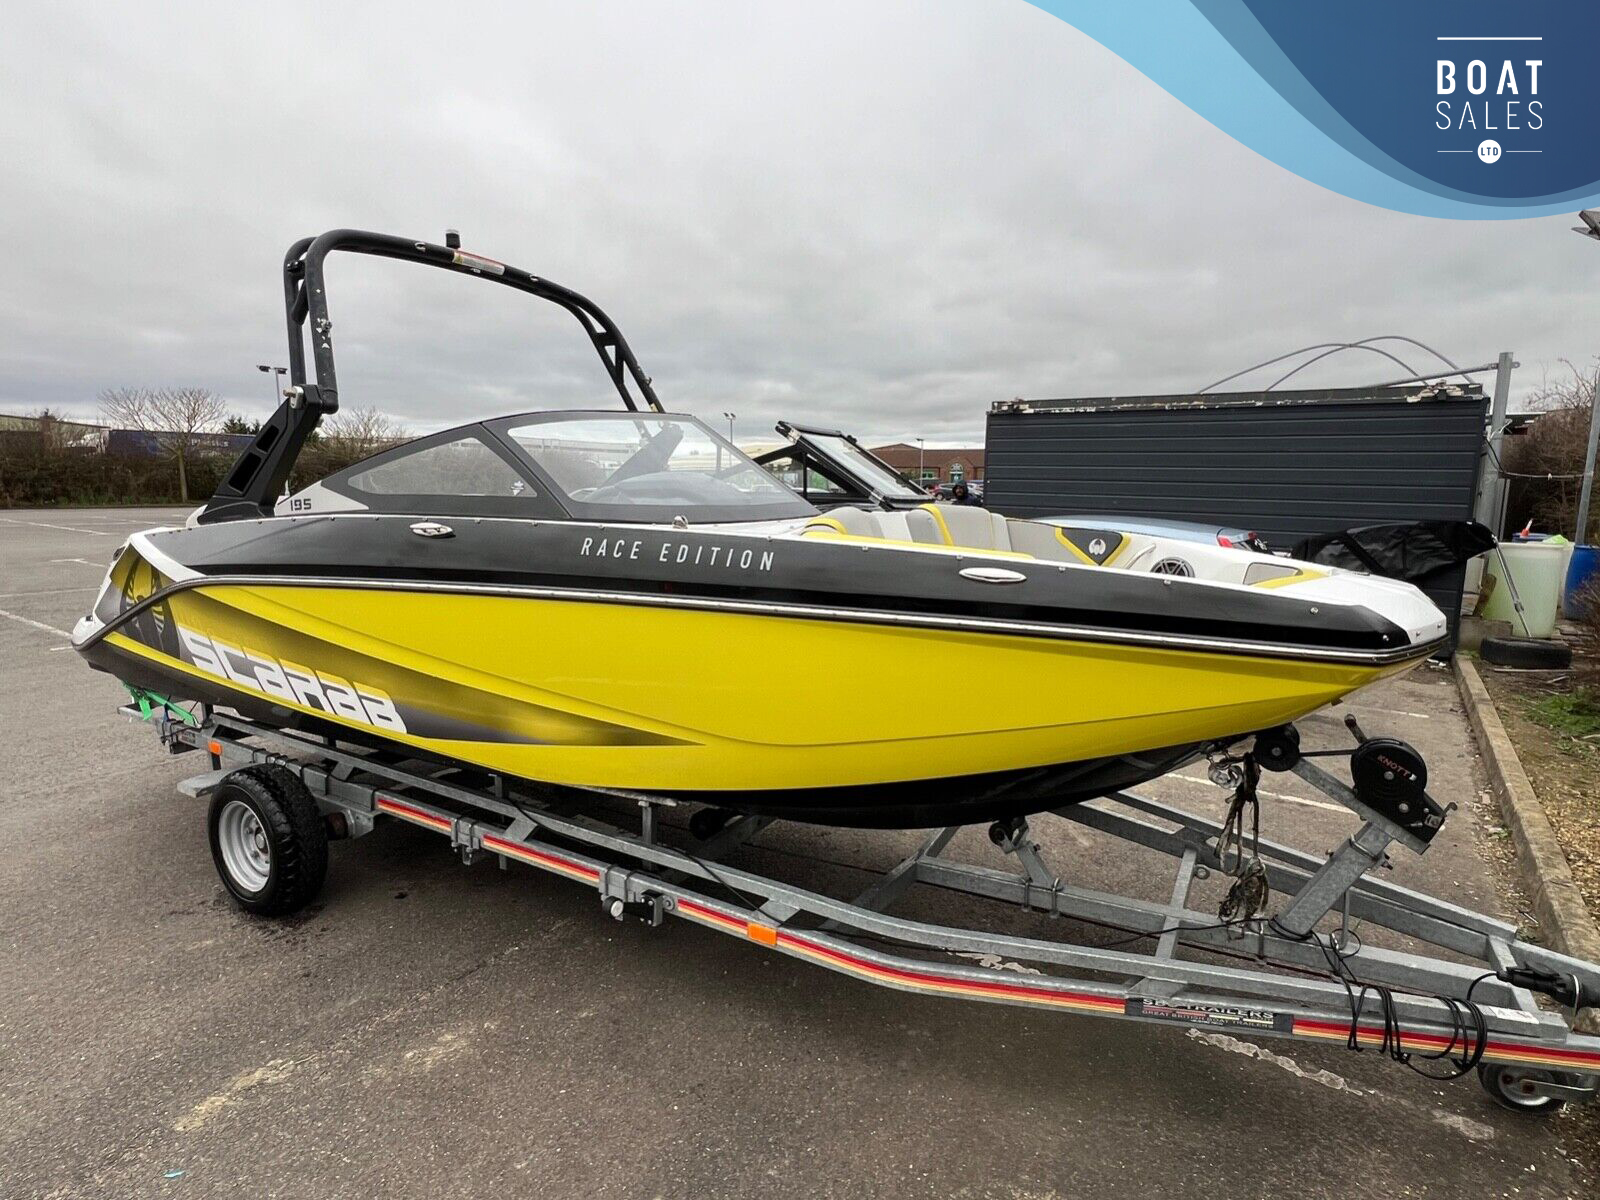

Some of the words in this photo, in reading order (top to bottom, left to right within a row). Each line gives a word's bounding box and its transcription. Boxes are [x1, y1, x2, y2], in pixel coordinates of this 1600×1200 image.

[290, 498, 312, 511] 195
[580, 537, 642, 560] RACE
[659, 543, 774, 571] EDITION
[177, 624, 408, 734] SCARAB
[1377, 754, 1412, 777] KNOTT
